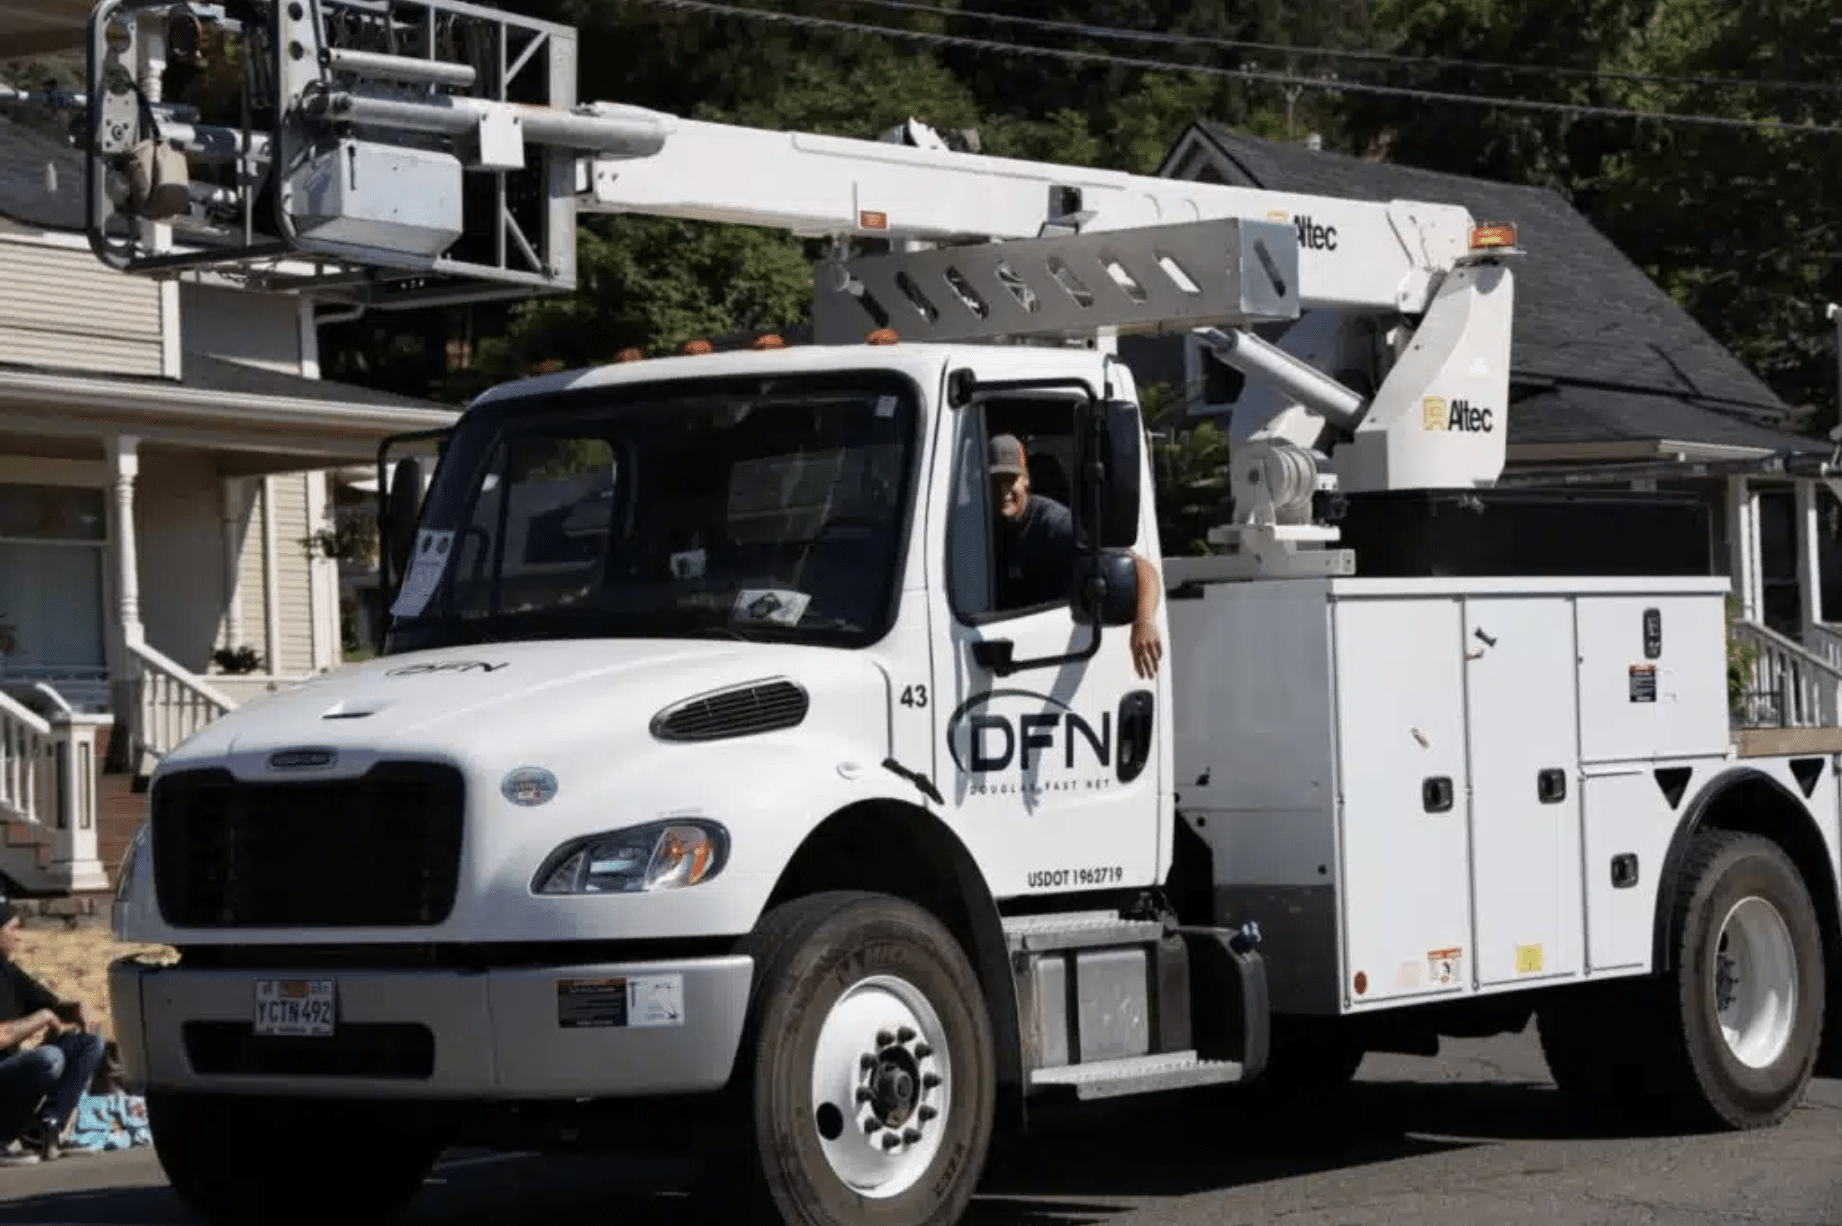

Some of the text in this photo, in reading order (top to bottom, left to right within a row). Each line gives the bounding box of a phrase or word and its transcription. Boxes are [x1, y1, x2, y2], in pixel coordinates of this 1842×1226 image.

[1447, 399, 1493, 433] Altec
[900, 684, 928, 709] 43
[970, 711, 1111, 773] DFN
[1044, 779, 1077, 791] FAST
[1086, 778, 1110, 790] NET
[1027, 866, 1123, 888] USDOT 1962719
